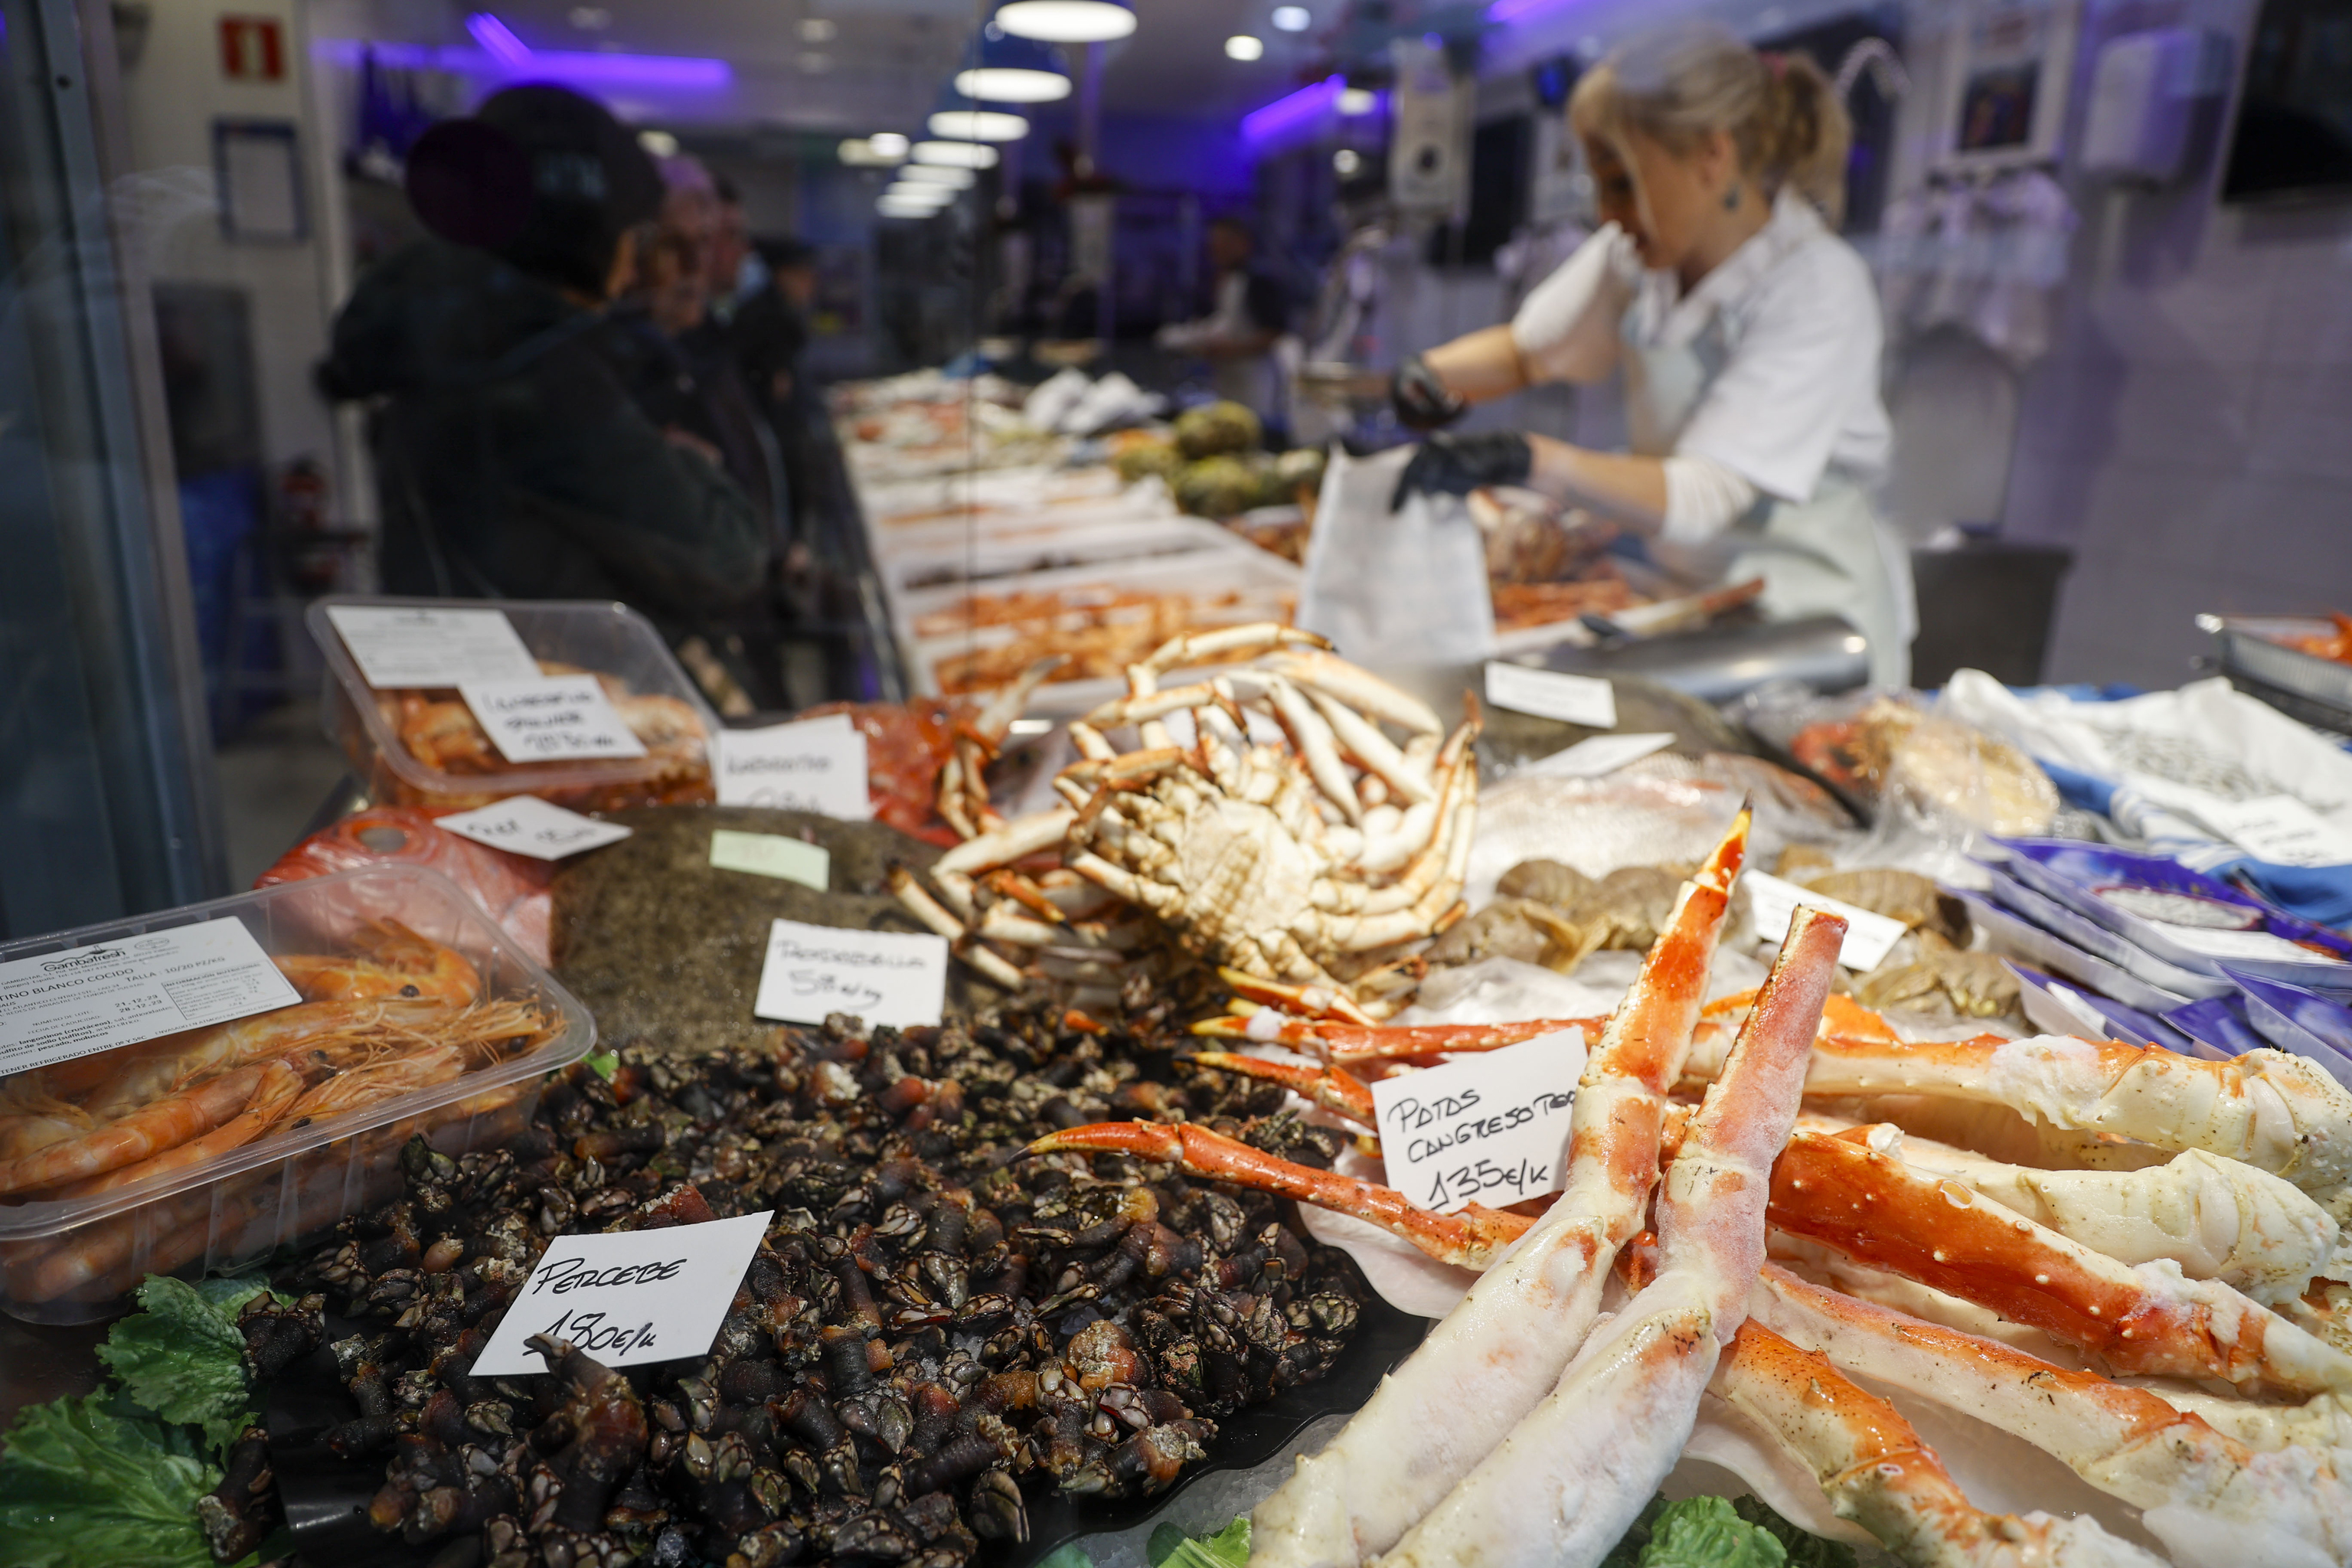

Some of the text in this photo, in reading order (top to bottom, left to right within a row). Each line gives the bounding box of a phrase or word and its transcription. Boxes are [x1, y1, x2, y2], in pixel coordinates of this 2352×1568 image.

[44, 949, 126, 972] Gambafresh
[32, 979, 84, 995] BLANCO
[87, 968, 133, 982] COCIDO
[125, 972, 156, 982] TALLA
[19, 1033, 63, 1045] langostinos
[36, 1038, 57, 1047] sodio
[38, 1040, 72, 1052] pescado,
[74, 1031, 109, 1043] moluscos
[1, 1064, 28, 1075] TENER
[29, 1050, 87, 1068] REFRIGERADO
[88, 1044, 114, 1054] ENTRE
[531, 1257, 688, 1295] PERCEBE
